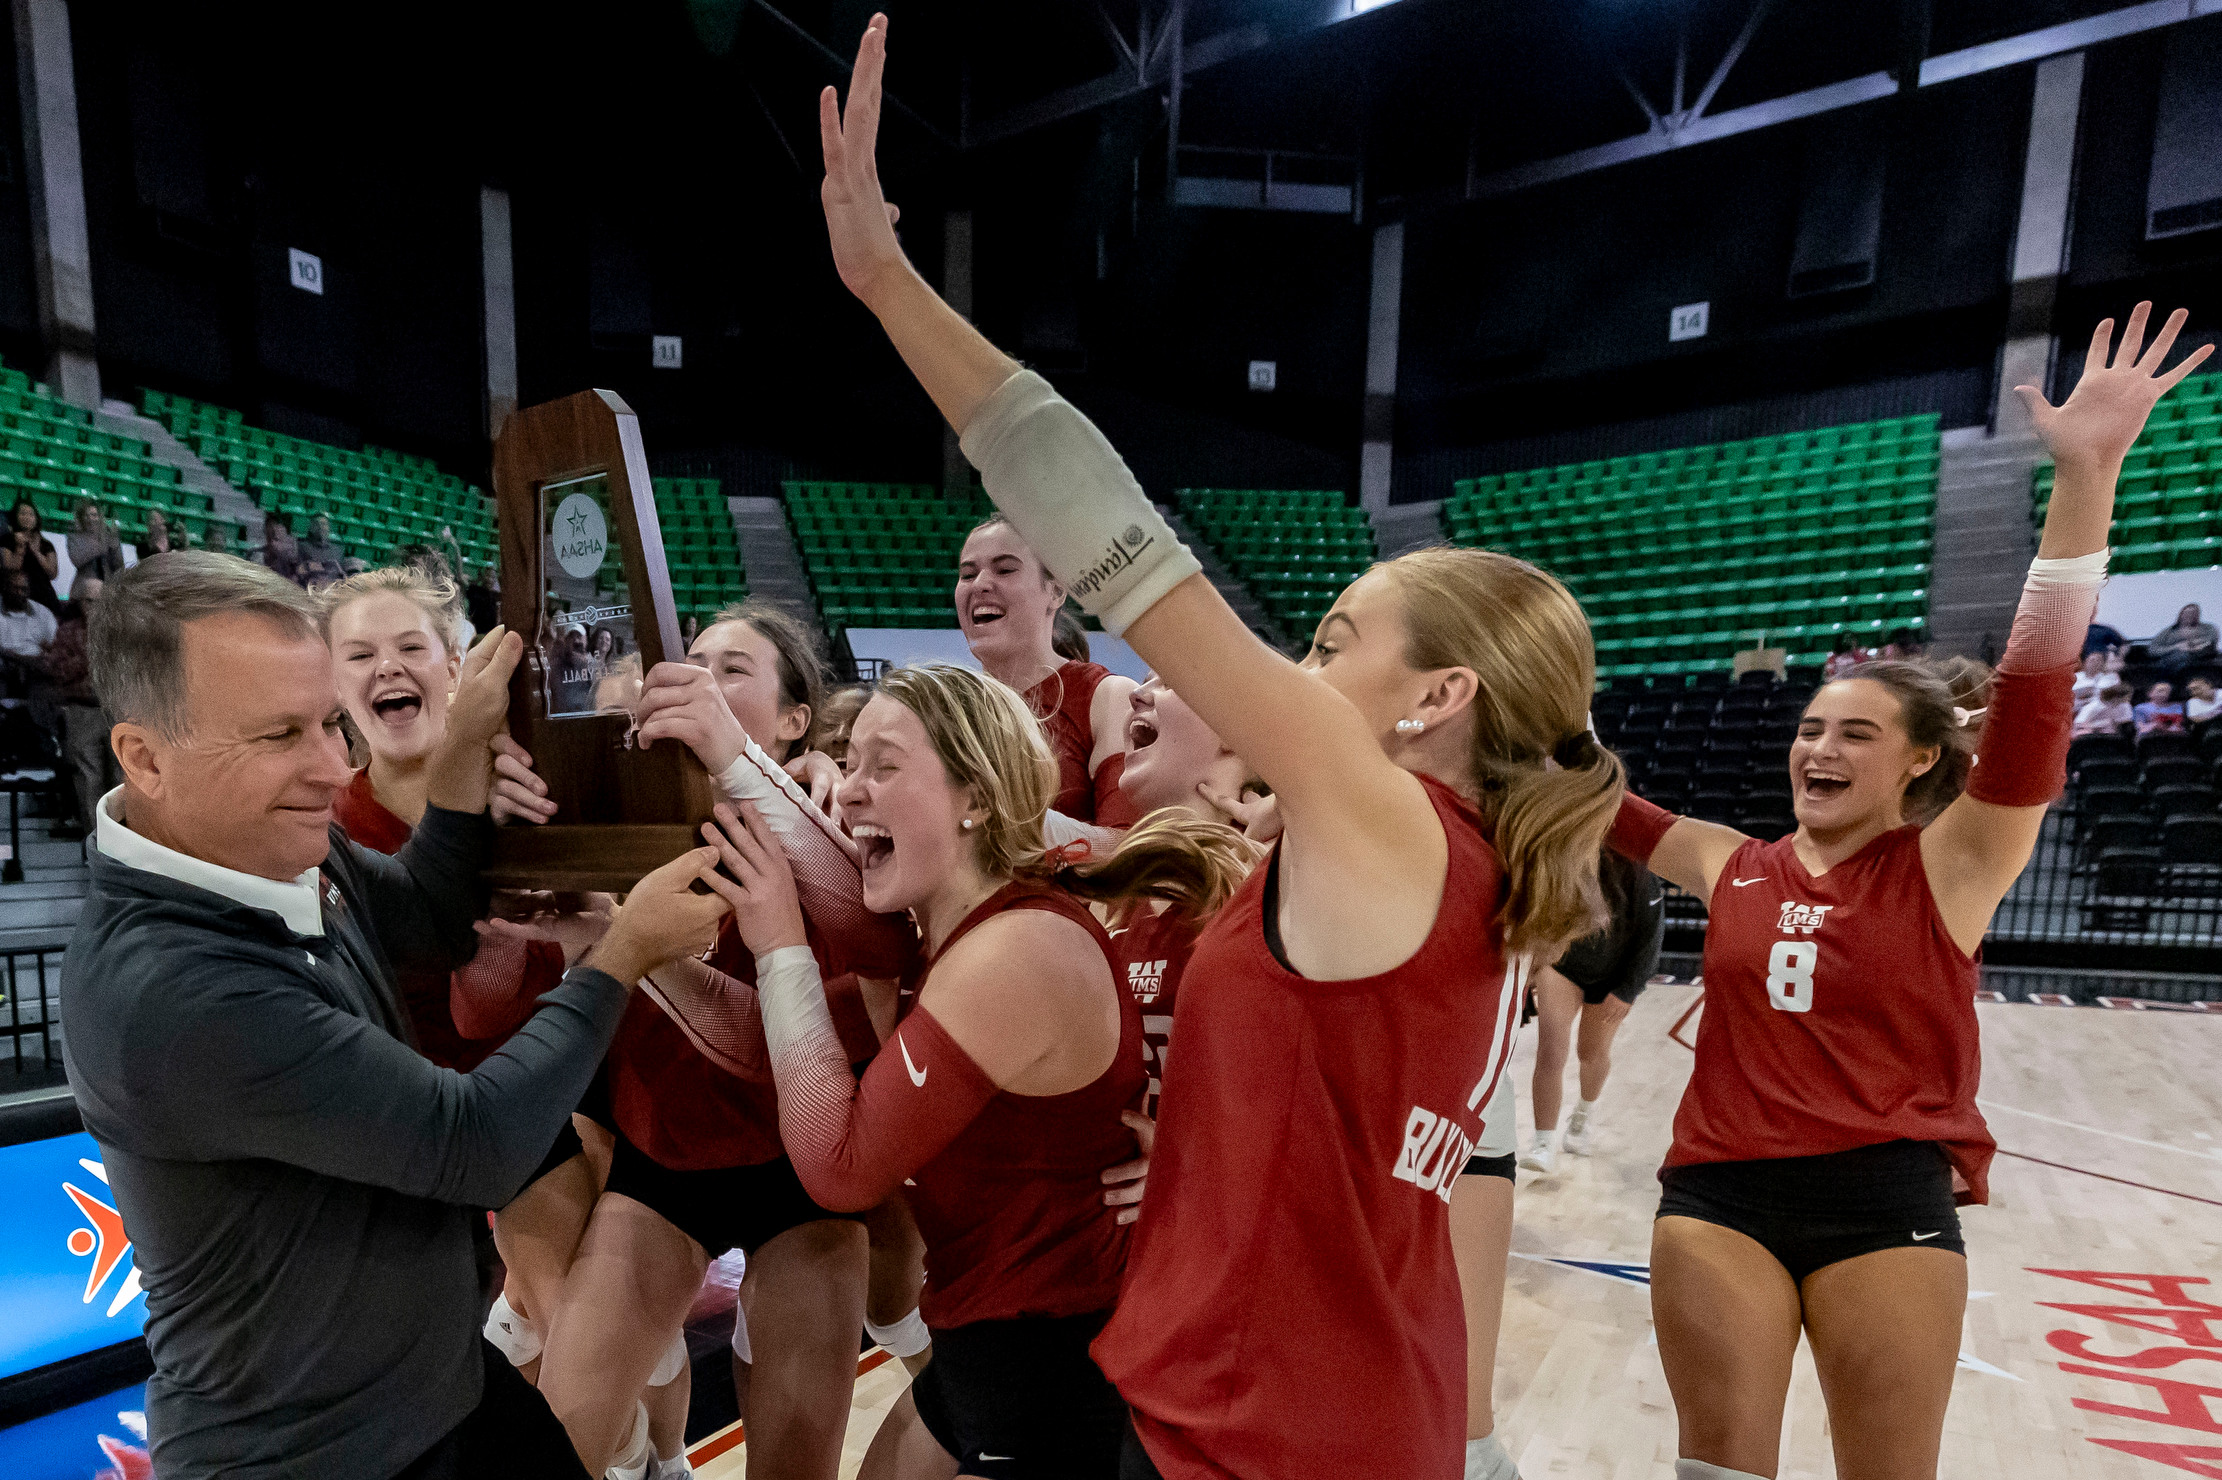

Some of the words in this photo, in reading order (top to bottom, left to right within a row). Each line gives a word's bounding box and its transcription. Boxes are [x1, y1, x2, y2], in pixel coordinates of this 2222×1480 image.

[297, 261, 317, 283] 10
[1680, 312, 1701, 330] 14
[660, 344, 676, 360] 11
[1766, 941, 1818, 1012] 8
